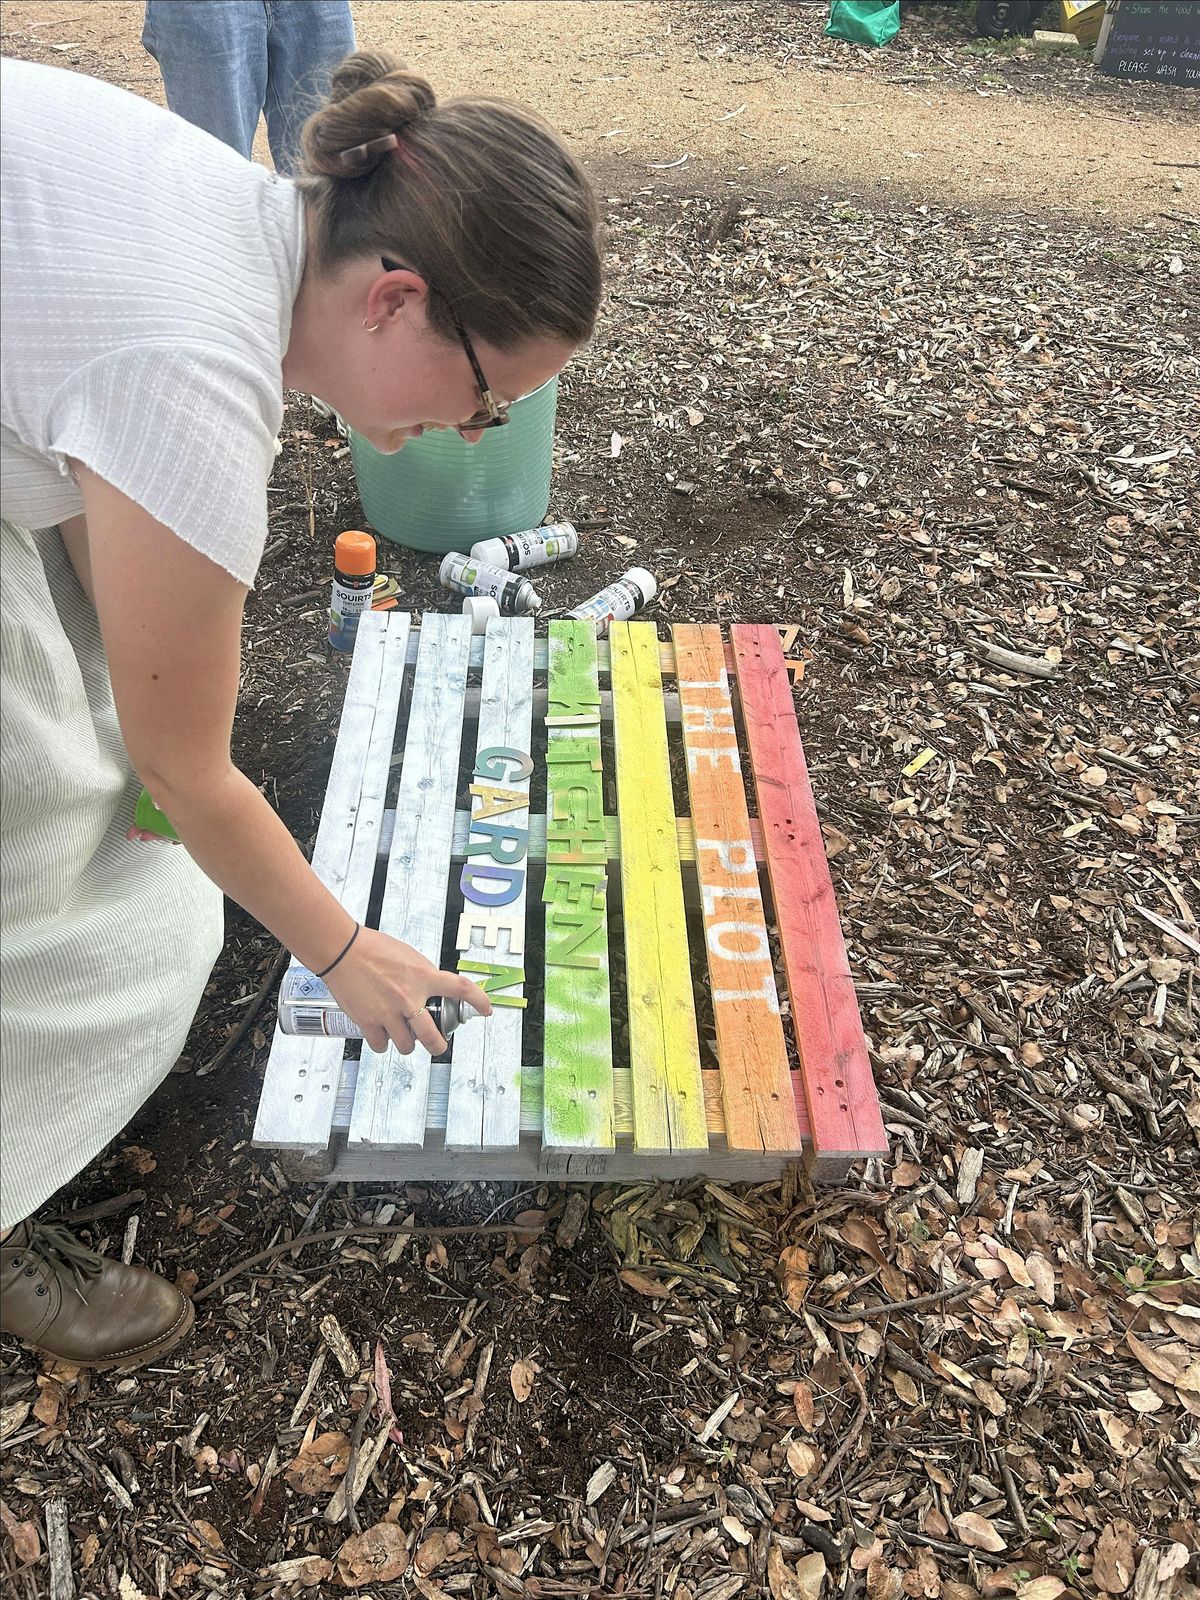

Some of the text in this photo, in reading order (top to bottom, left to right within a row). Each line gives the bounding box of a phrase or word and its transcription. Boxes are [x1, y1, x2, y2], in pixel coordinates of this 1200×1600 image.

[1118, 60, 1150, 73] PLEASE
[1156, 64, 1178, 77] WASH
[1143, 47, 1155, 56] set
[456, 746, 535, 1008] GARDEN
[542, 696, 608, 970] KITCHEN
[679, 668, 780, 1015] THE PLOT
